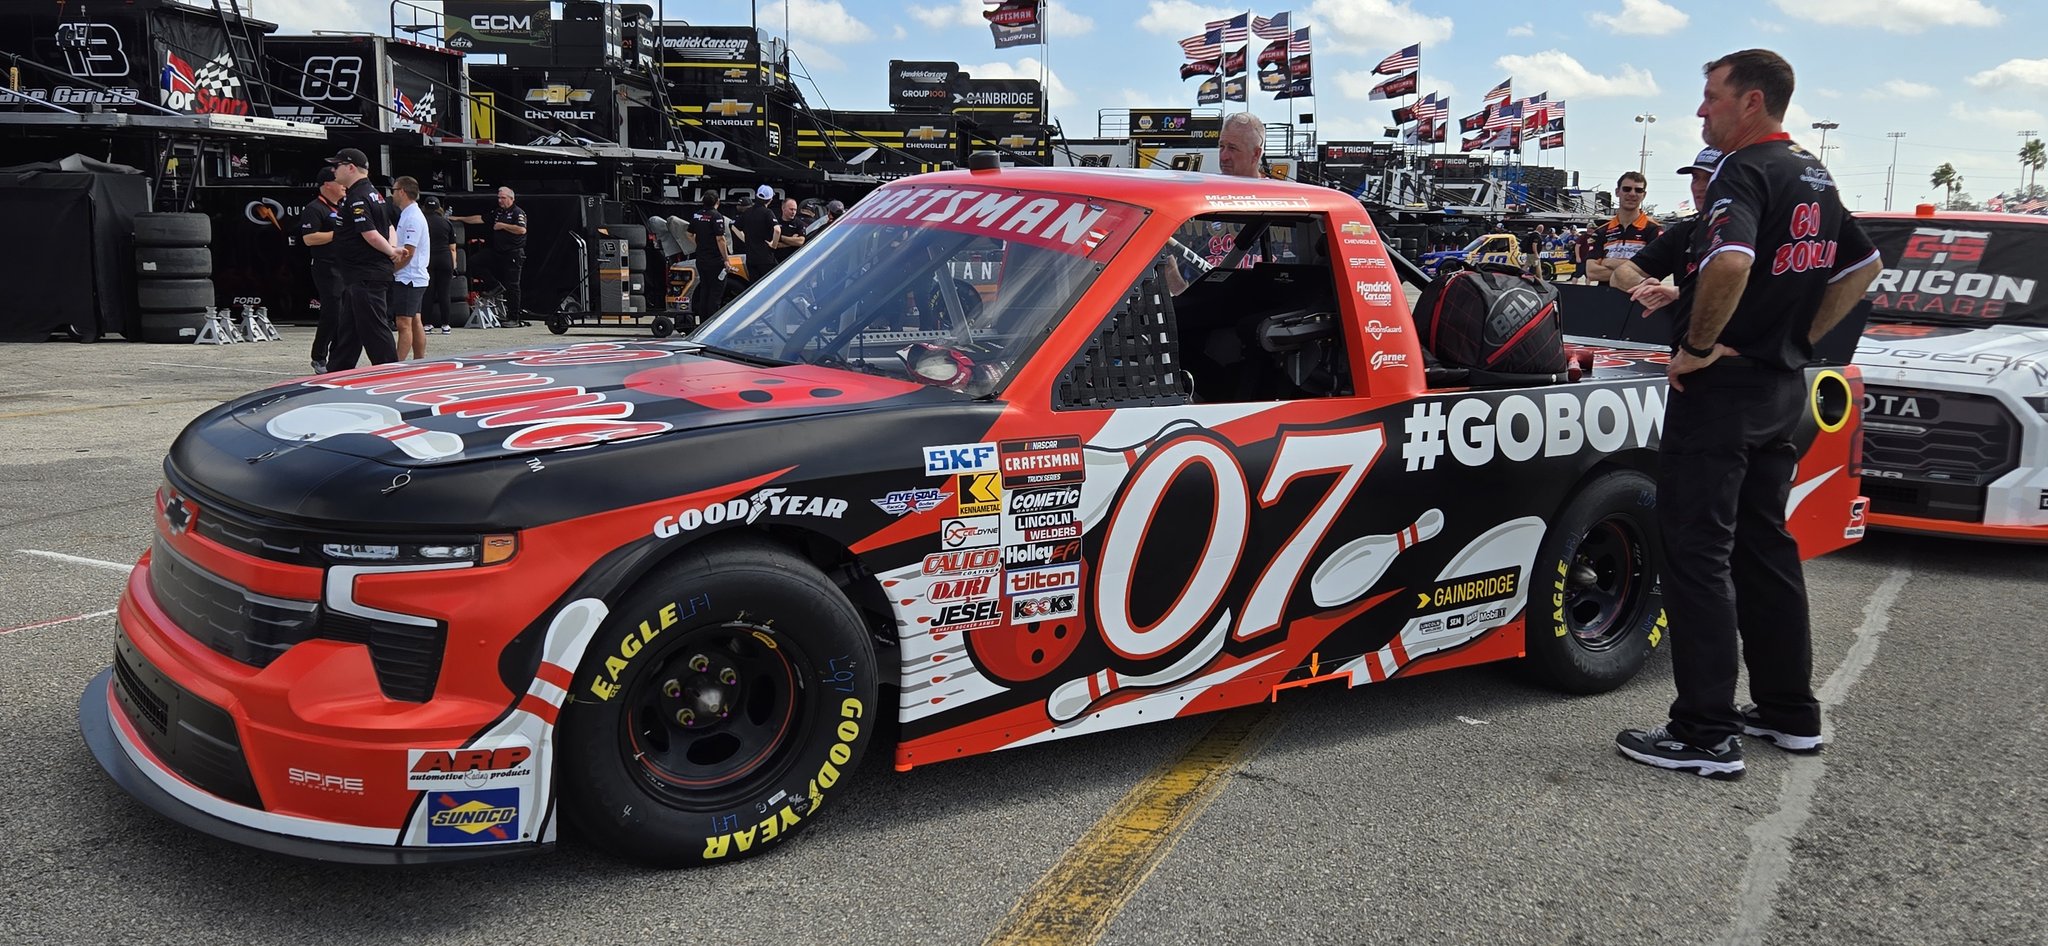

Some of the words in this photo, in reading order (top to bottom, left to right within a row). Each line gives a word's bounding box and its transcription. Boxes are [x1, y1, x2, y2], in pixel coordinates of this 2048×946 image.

[470, 15, 531, 30] GCM
[300, 56, 363, 101] 66
[50, 86, 140, 105] Garcia
[1789, 201, 1821, 240] GO
[1343, 238, 1378, 246] CHEVROLET
[233, 297, 261, 305] FORD
[1491, 293, 1537, 338] BELL
[1032, 440, 1058, 450] NASCAR
[525, 456, 546, 473] TM
[929, 446, 995, 472] SKF
[1004, 452, 1080, 472] CRAFTSMAN
[887, 493, 912, 504] FIVE
[914, 490, 939, 501] STAR
[1012, 487, 1080, 511] COMETIC
[959, 503, 1001, 515] KENNAMETAL
[1017, 512, 1071, 530] LINCOLN
[1029, 525, 1077, 541] WELDERS
[1093, 420, 1388, 661] 07
[922, 547, 1001, 575] CALICO
[1005, 545, 1054, 565] Holley
[930, 577, 993, 601] DART
[1010, 570, 1076, 592] tilton
[1434, 573, 1516, 608] GAINBRIDGE
[1552, 560, 1570, 638] EAGLE
[930, 602, 1001, 627] JESEL
[590, 601, 679, 701] EAGLE
[409, 746, 533, 773] ARP
[409, 772, 464, 782] automotive
[490, 768, 531, 780] products
[435, 807, 518, 825] SUNOCO
